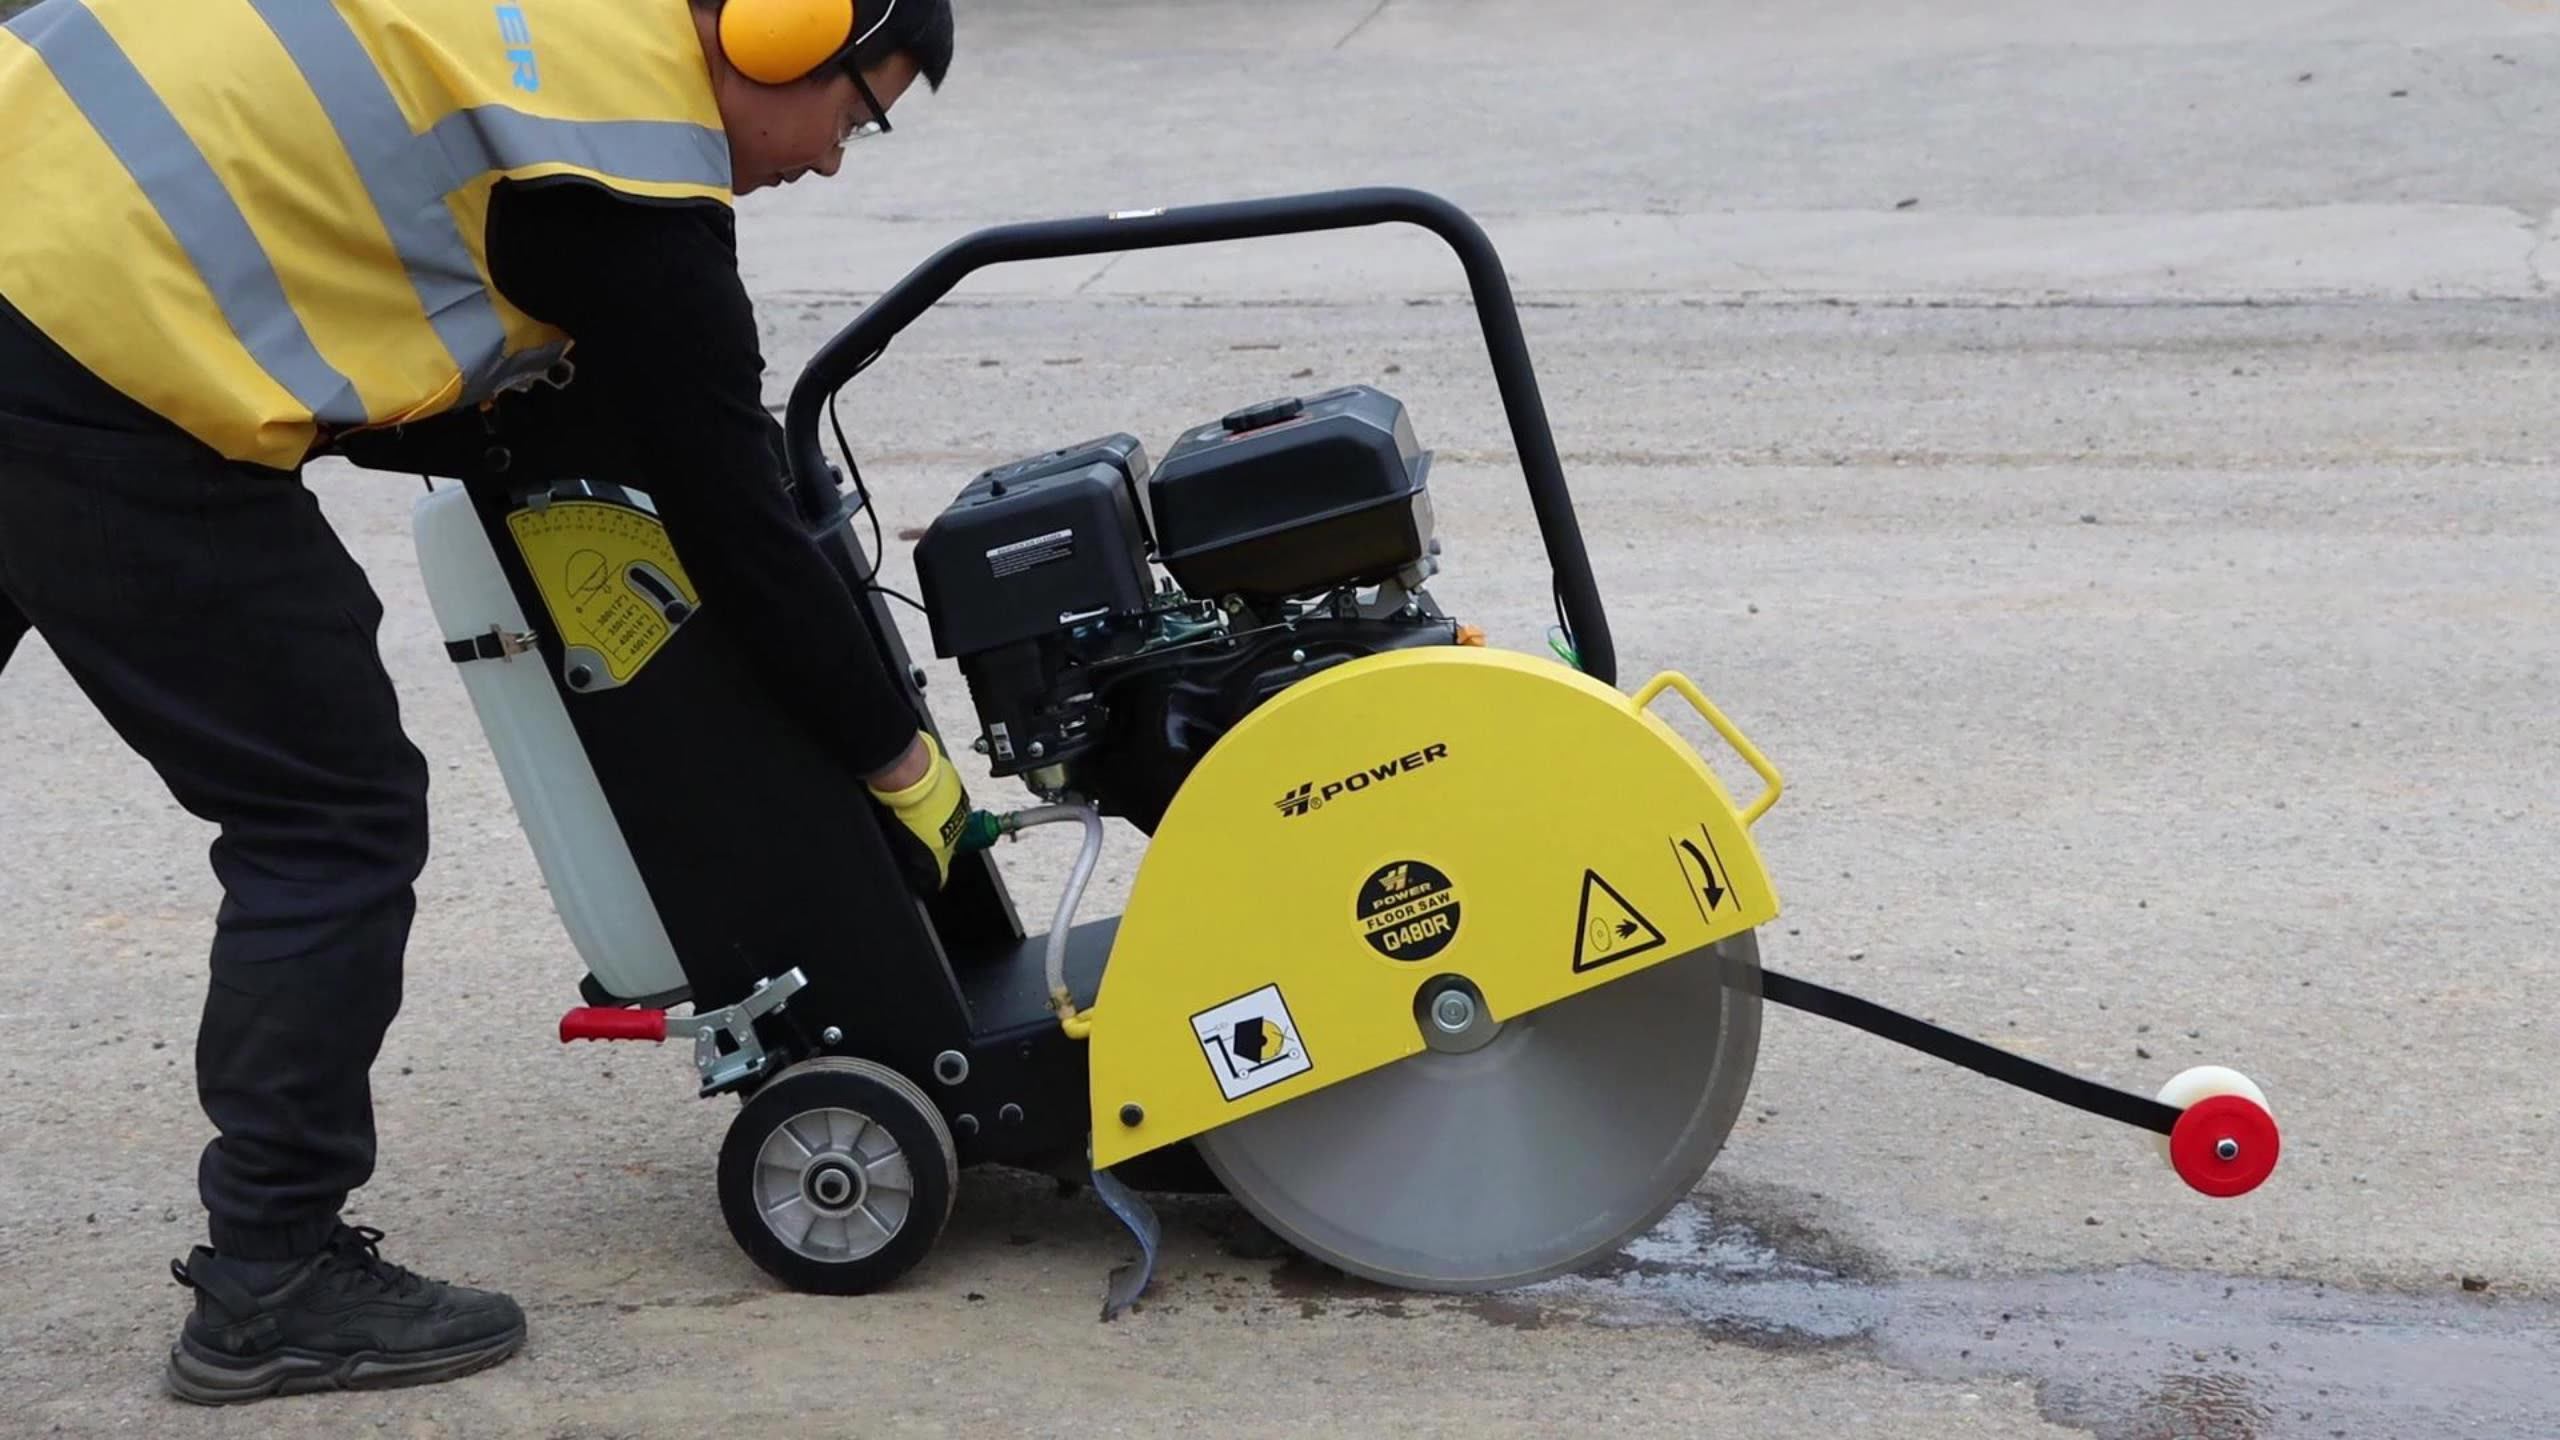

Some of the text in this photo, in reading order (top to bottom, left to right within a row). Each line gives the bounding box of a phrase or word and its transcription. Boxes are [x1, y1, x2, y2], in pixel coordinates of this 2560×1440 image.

[495, 0, 541, 93] ER
[1321, 742, 1449, 802] POWER
[1366, 891, 1452, 931] FLOOR SAW
[1371, 881, 1432, 910] POWER
[1382, 912, 1452, 952] Q480R
